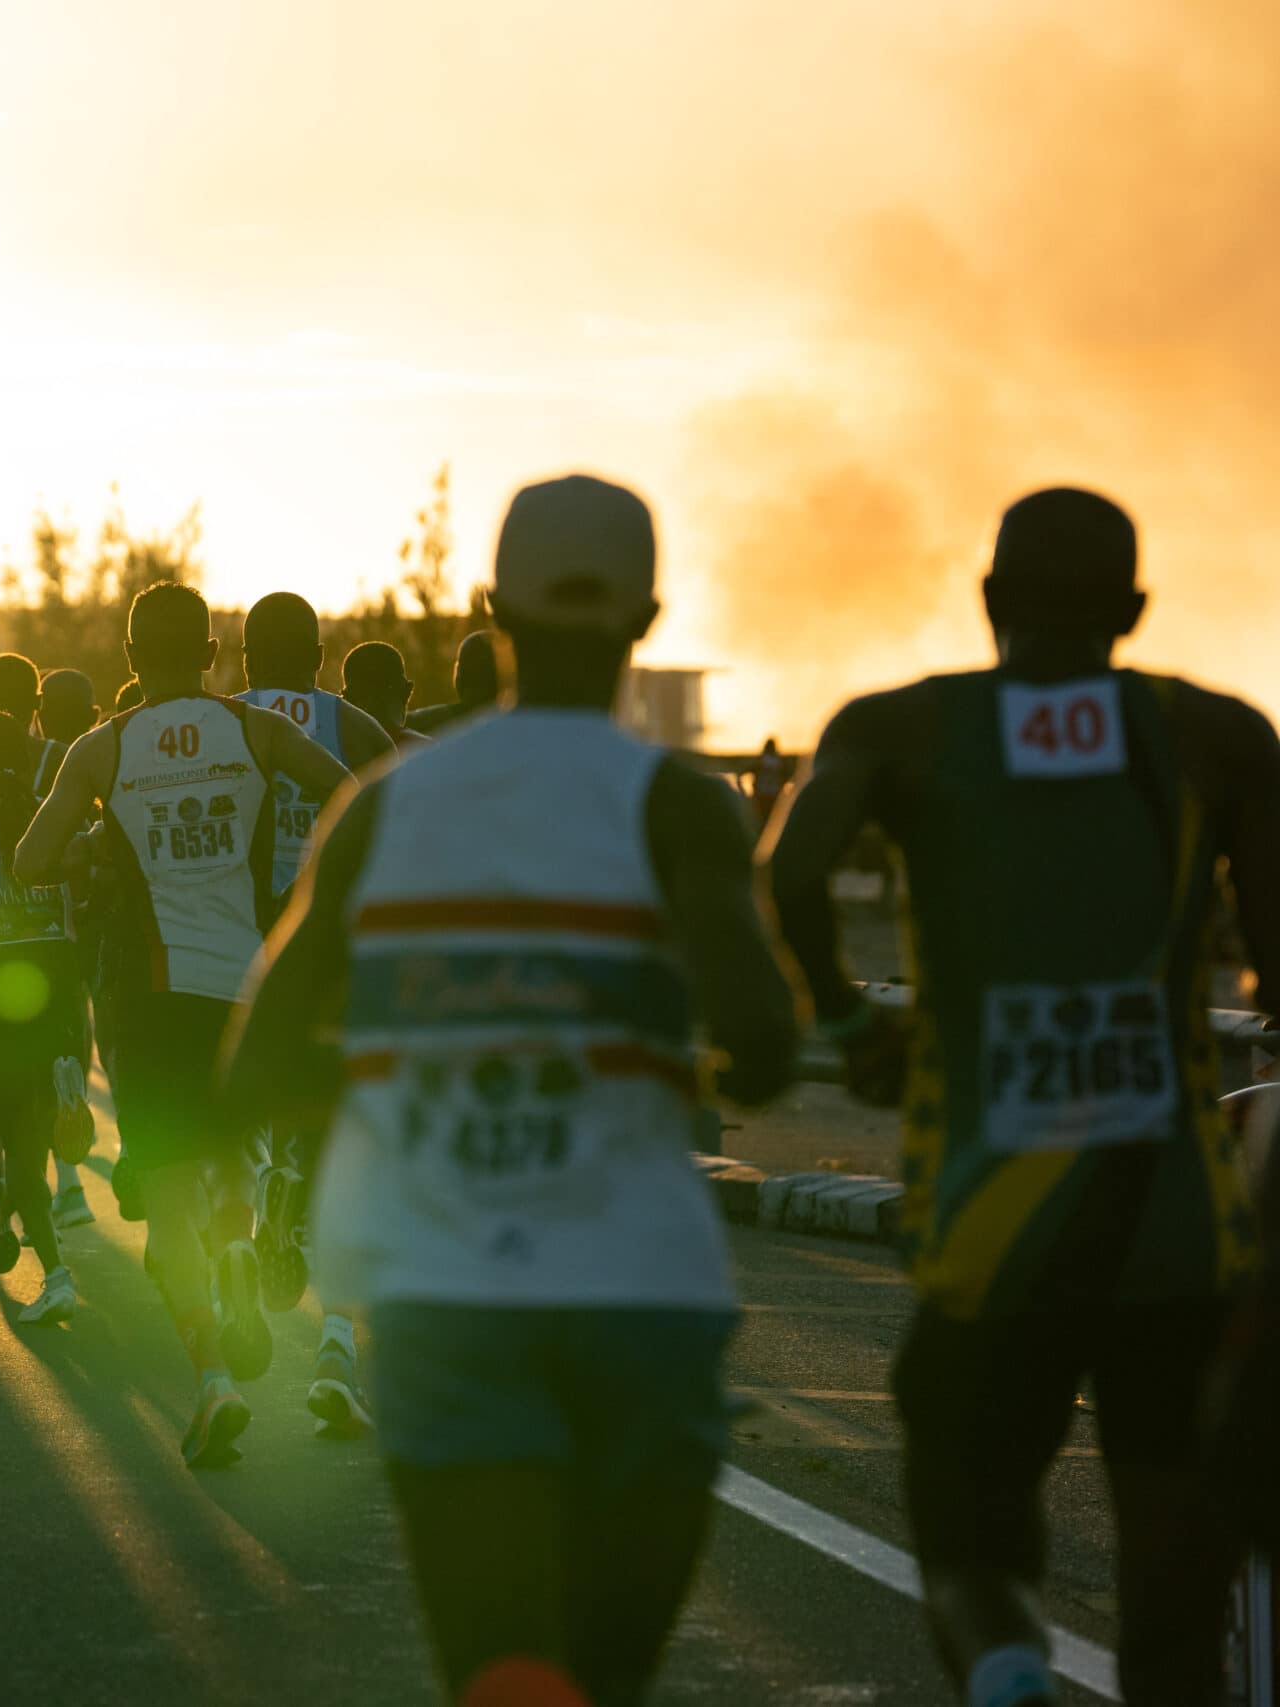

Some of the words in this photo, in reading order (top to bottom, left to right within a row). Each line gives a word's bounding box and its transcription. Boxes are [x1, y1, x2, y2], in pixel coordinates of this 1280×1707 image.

[270, 695, 310, 725] 40
[1019, 698, 1107, 757] 40
[158, 723, 200, 759] 40
[137, 767, 207, 787] BRIMSTONE
[147, 828, 162, 861] P
[170, 822, 235, 860] 6534
[1027, 1035, 1165, 1105] 2165
